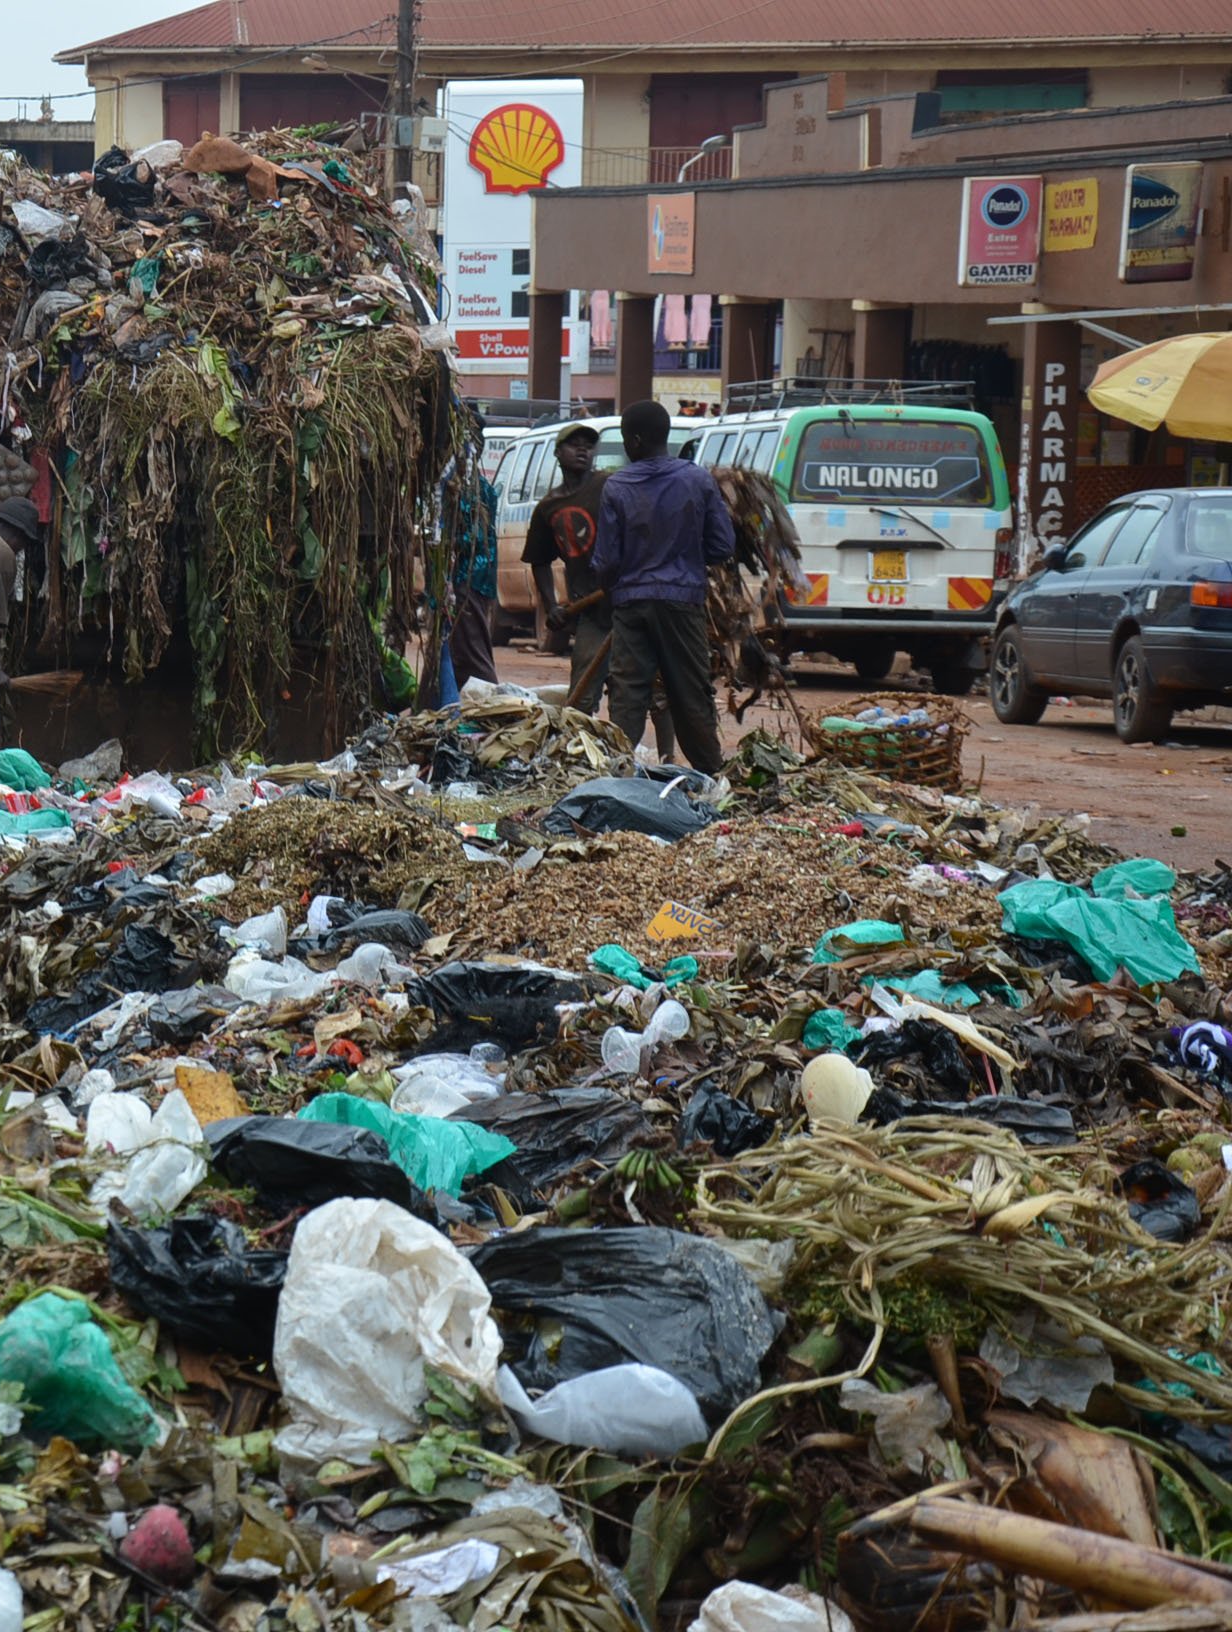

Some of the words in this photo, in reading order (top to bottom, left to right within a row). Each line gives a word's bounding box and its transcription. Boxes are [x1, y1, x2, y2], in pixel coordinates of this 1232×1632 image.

[1054, 188, 1086, 209] GAYATRI
[1132, 195, 1177, 209] Panadol
[989, 199, 1021, 213] Panadol
[1049, 215, 1094, 238] PHARMACY
[458, 251, 498, 261] FuelSave
[458, 265, 486, 274] Diesel
[969, 264, 1033, 277] GAYATRI
[975, 276, 1028, 284] PHARMACY
[458, 294, 497, 304] FuelSave
[458, 307, 501, 317] Unleaded
[480, 332, 503, 342] Shell
[480, 342, 529, 355] V-Pow
[819, 465, 938, 488] NALONGO
